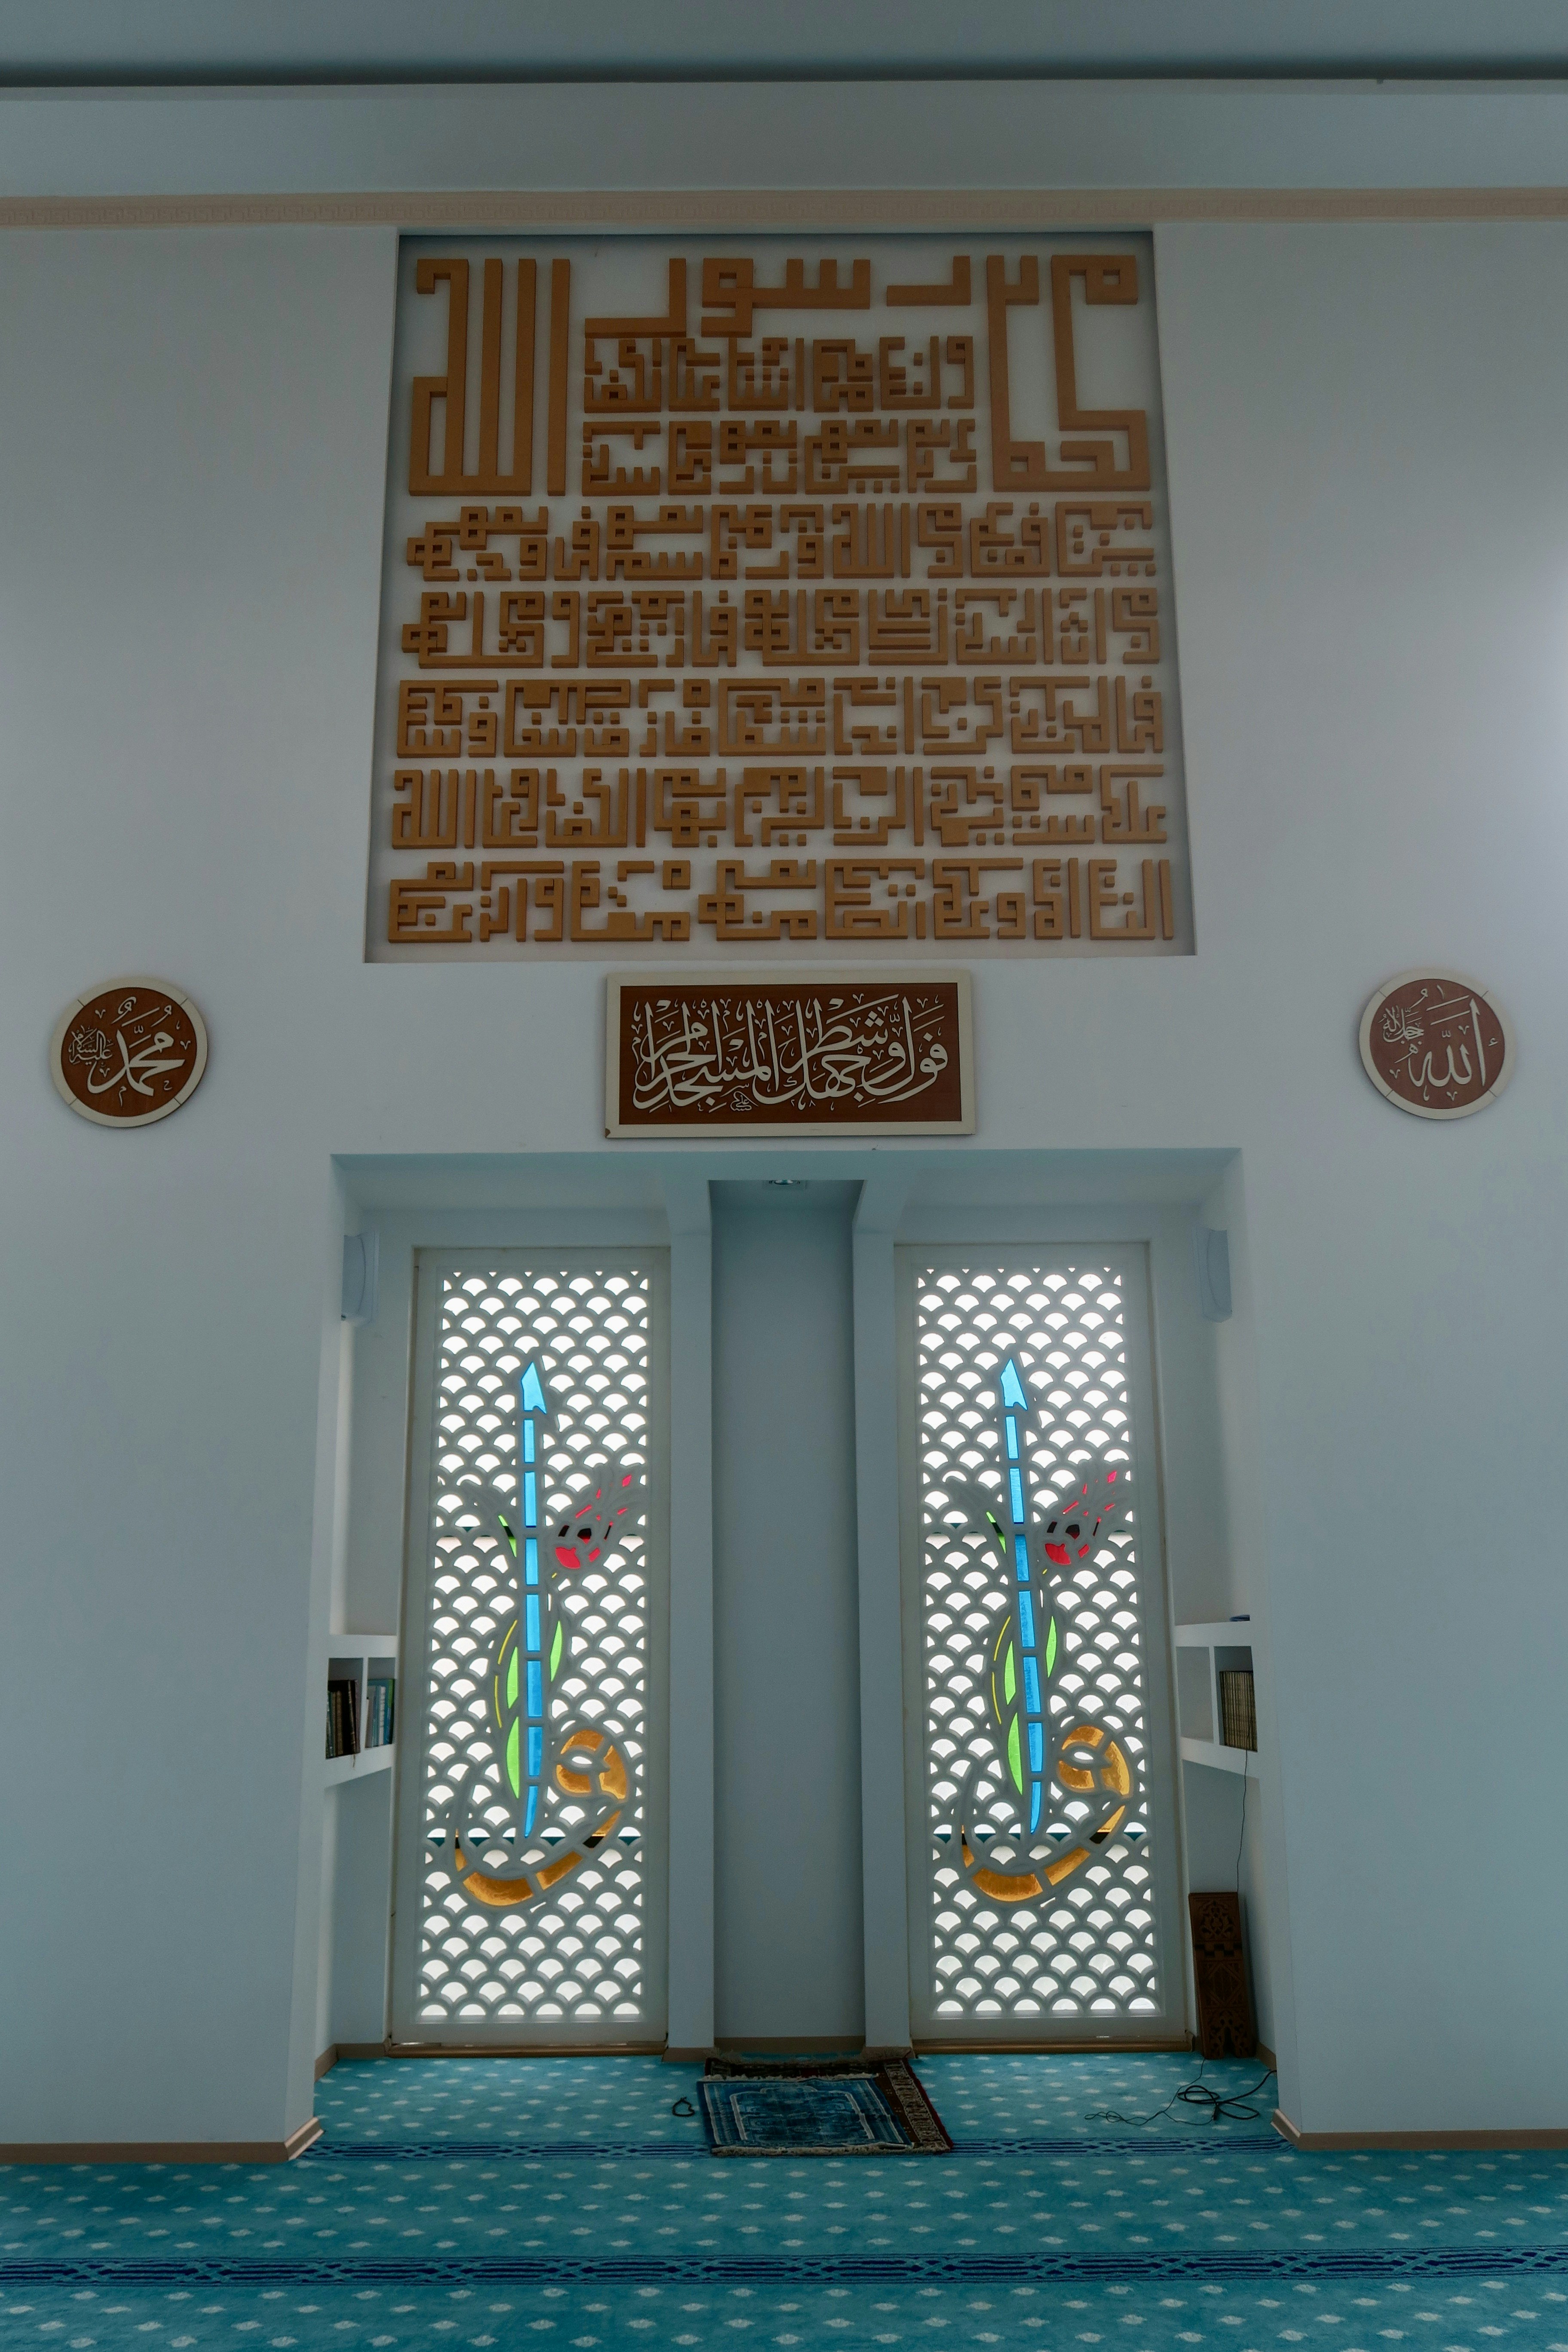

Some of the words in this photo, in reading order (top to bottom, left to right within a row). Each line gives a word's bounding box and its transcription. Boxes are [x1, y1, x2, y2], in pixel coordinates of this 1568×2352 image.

[409, 258, 570, 496] الله
[87, 1029, 185, 1097] محمد
[1407, 998, 1486, 1087] الله
